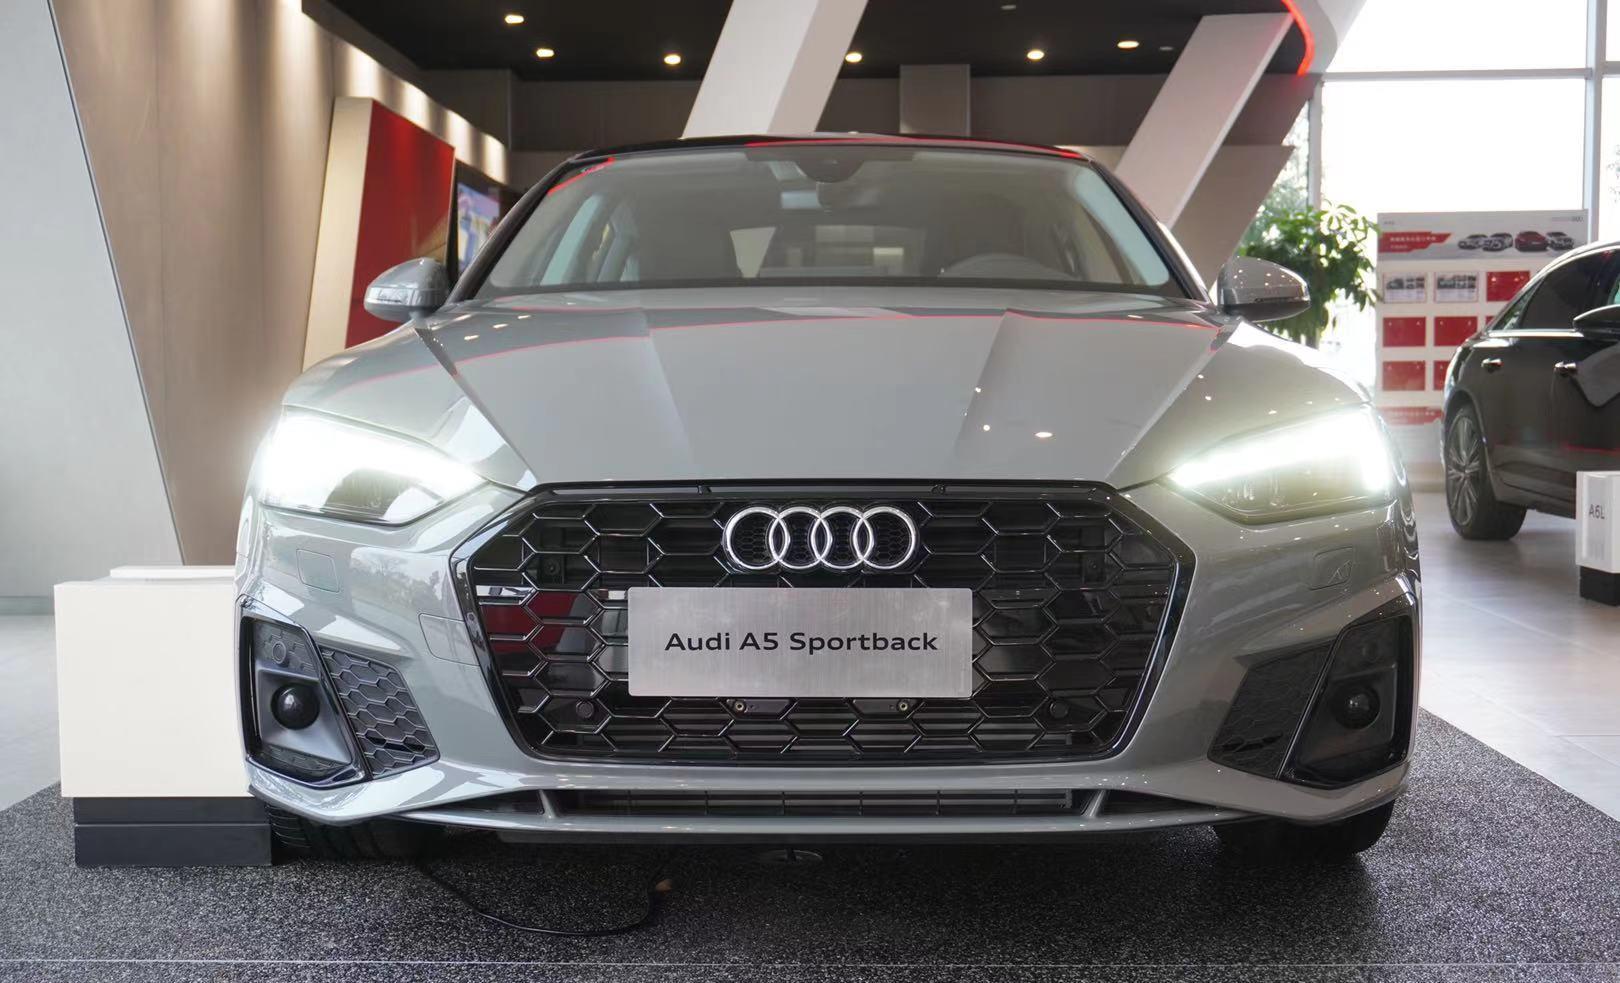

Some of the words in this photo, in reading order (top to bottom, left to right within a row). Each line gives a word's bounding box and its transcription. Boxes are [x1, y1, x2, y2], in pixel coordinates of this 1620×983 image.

[1589, 504, 1605, 519] A6L
[664, 632, 731, 651] Audi
[738, 632, 779, 651] A5
[789, 631, 939, 656] Sportback
